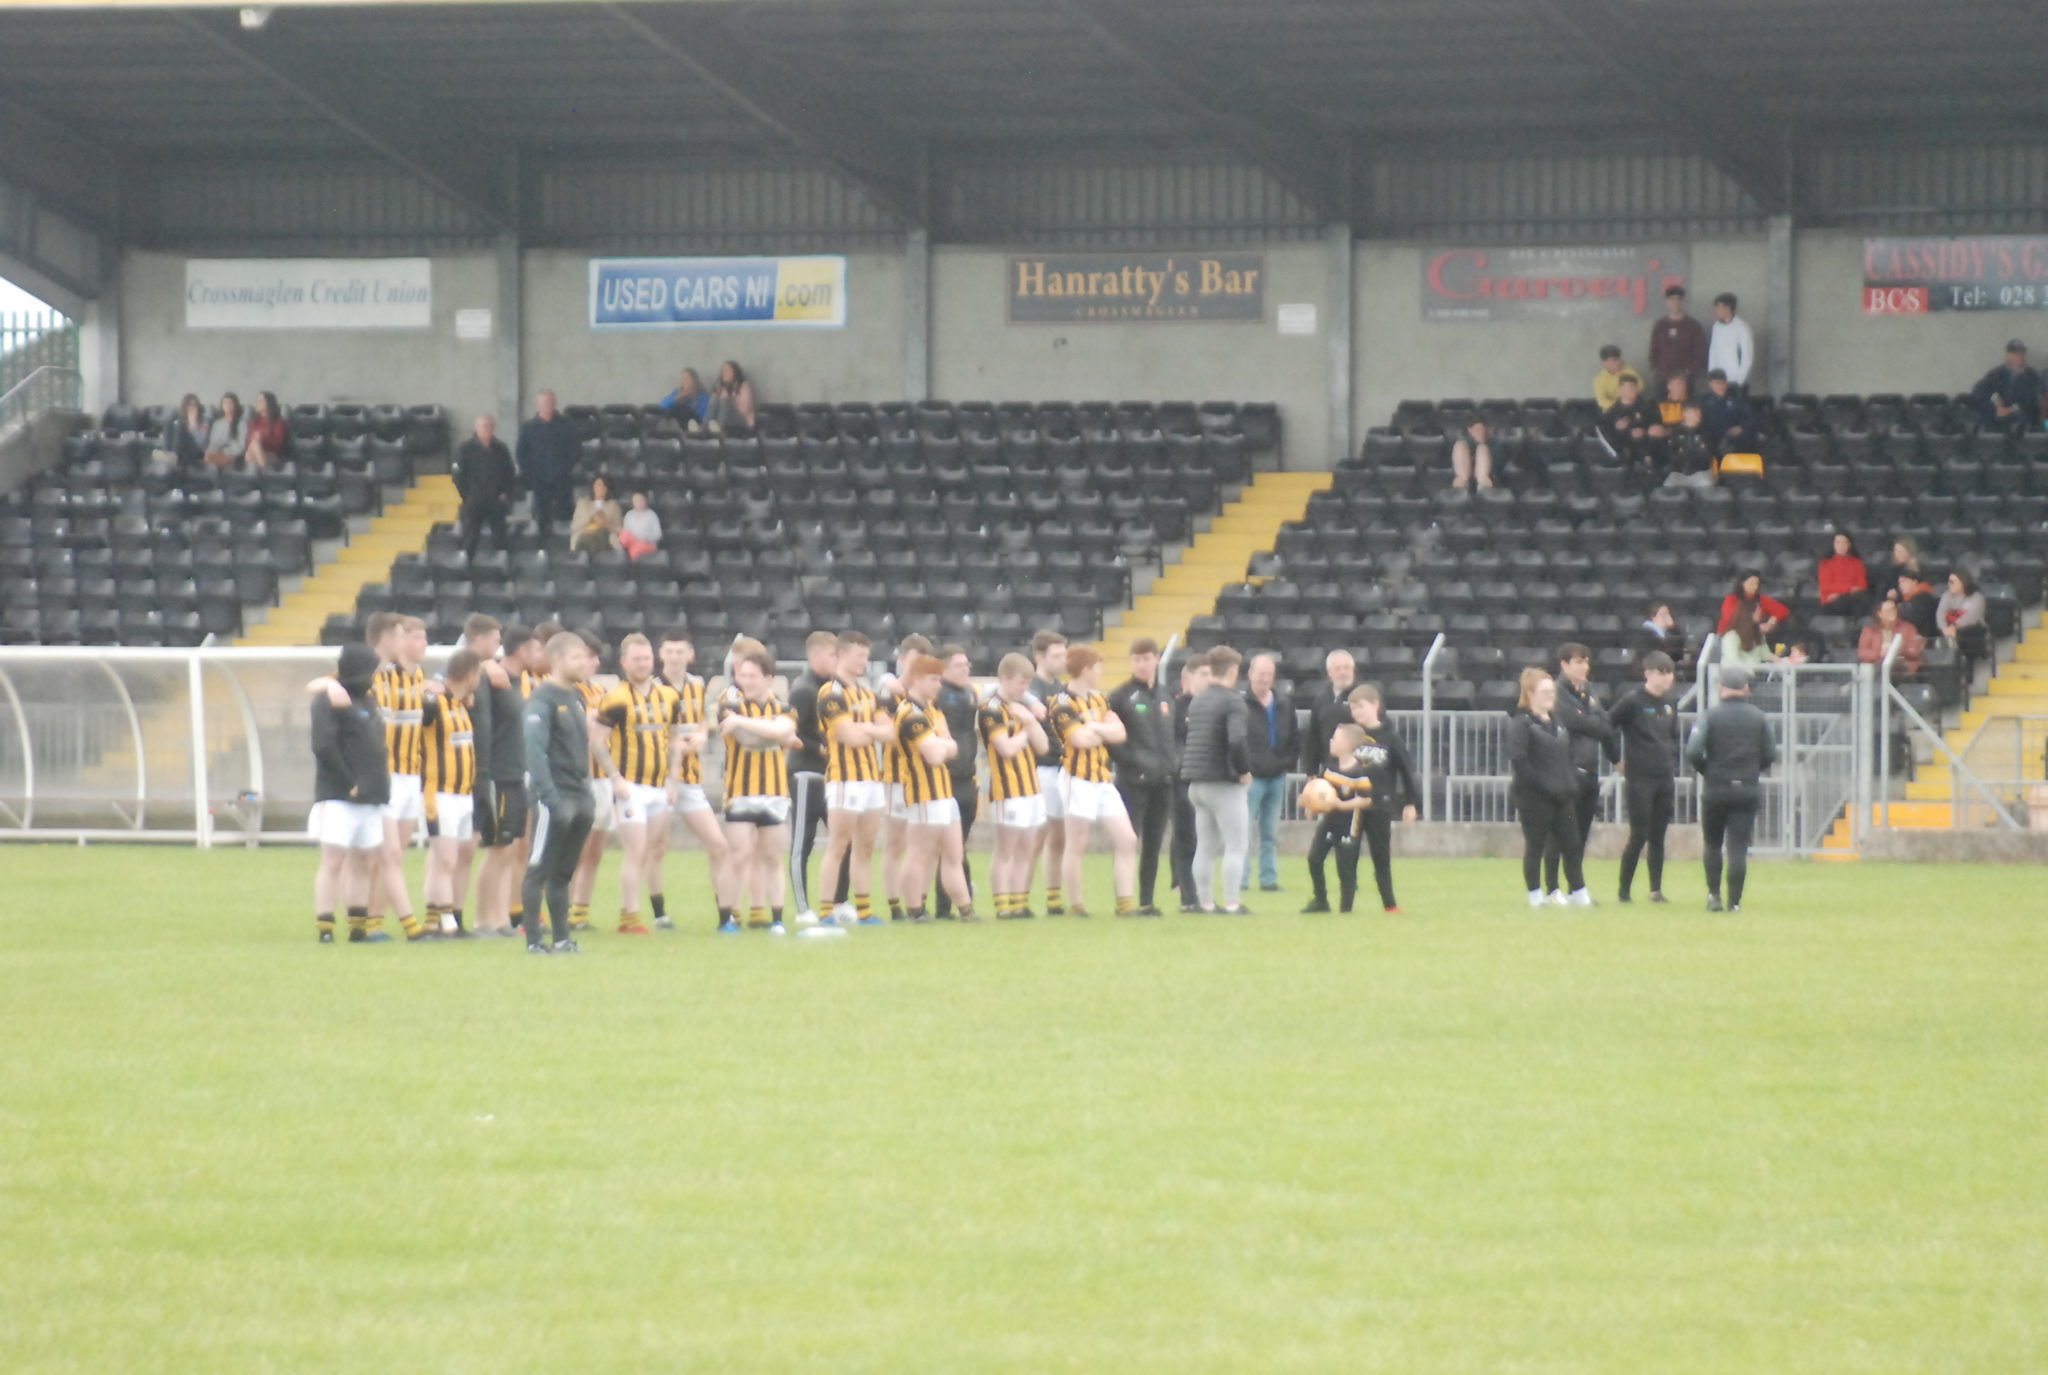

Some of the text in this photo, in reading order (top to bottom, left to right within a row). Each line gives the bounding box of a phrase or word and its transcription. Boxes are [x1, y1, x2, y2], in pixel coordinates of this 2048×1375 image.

[1865, 241, 2048, 279] CASSIDY'S G
[188, 280, 429, 309] Crossmaglen Credit Union
[604, 278, 667, 311] USED
[674, 276, 739, 309] CARS
[1016, 258, 1257, 306] Hanratty's Bar
[1951, 286, 1986, 306] Tel:
[2000, 285, 2035, 306] 028
[1871, 288, 1920, 313] BCS
